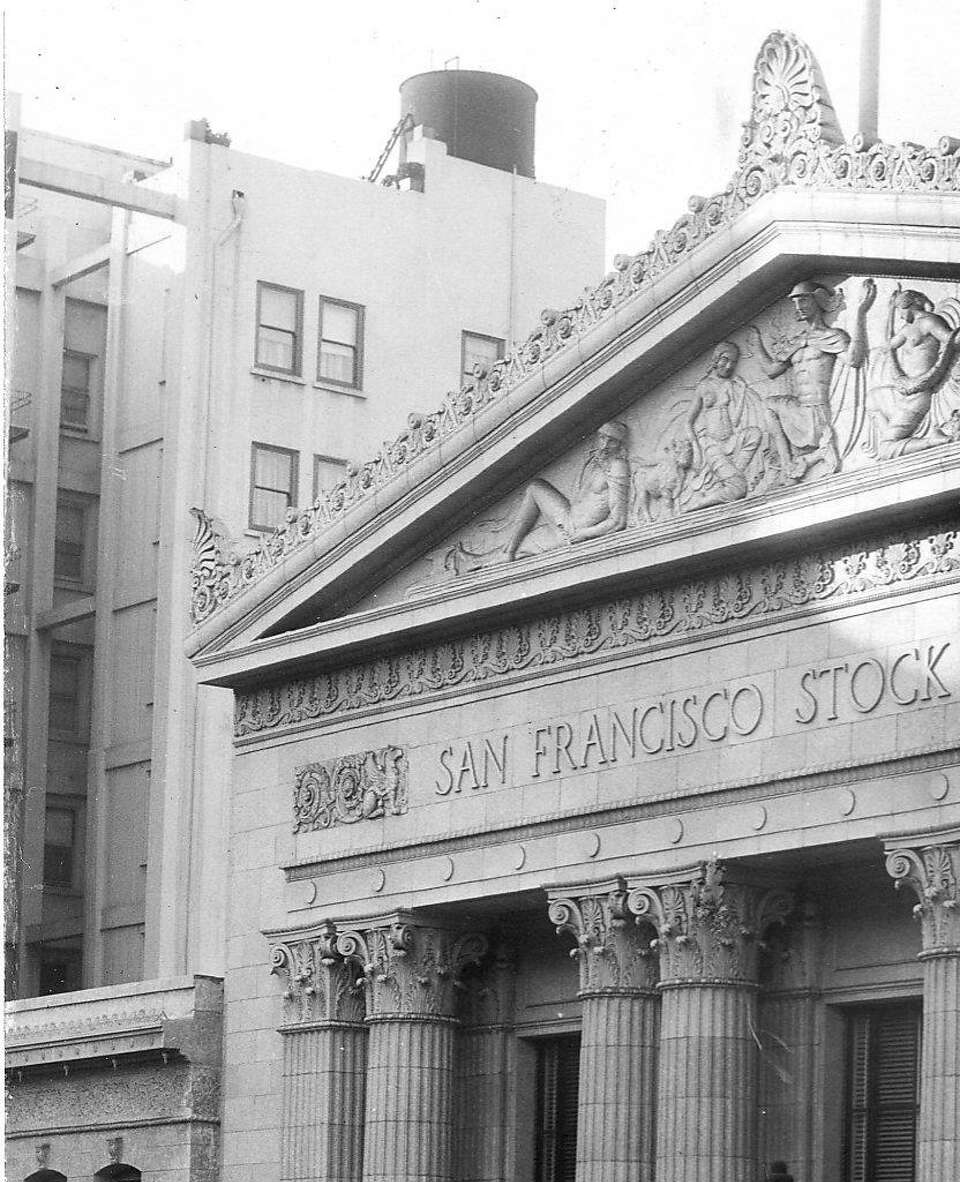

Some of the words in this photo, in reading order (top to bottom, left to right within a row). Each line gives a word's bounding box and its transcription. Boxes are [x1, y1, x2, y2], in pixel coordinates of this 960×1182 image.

[435, 734, 508, 796] SAN
[529, 683, 765, 778] FRANCISCO
[796, 642, 951, 725] STOCK
